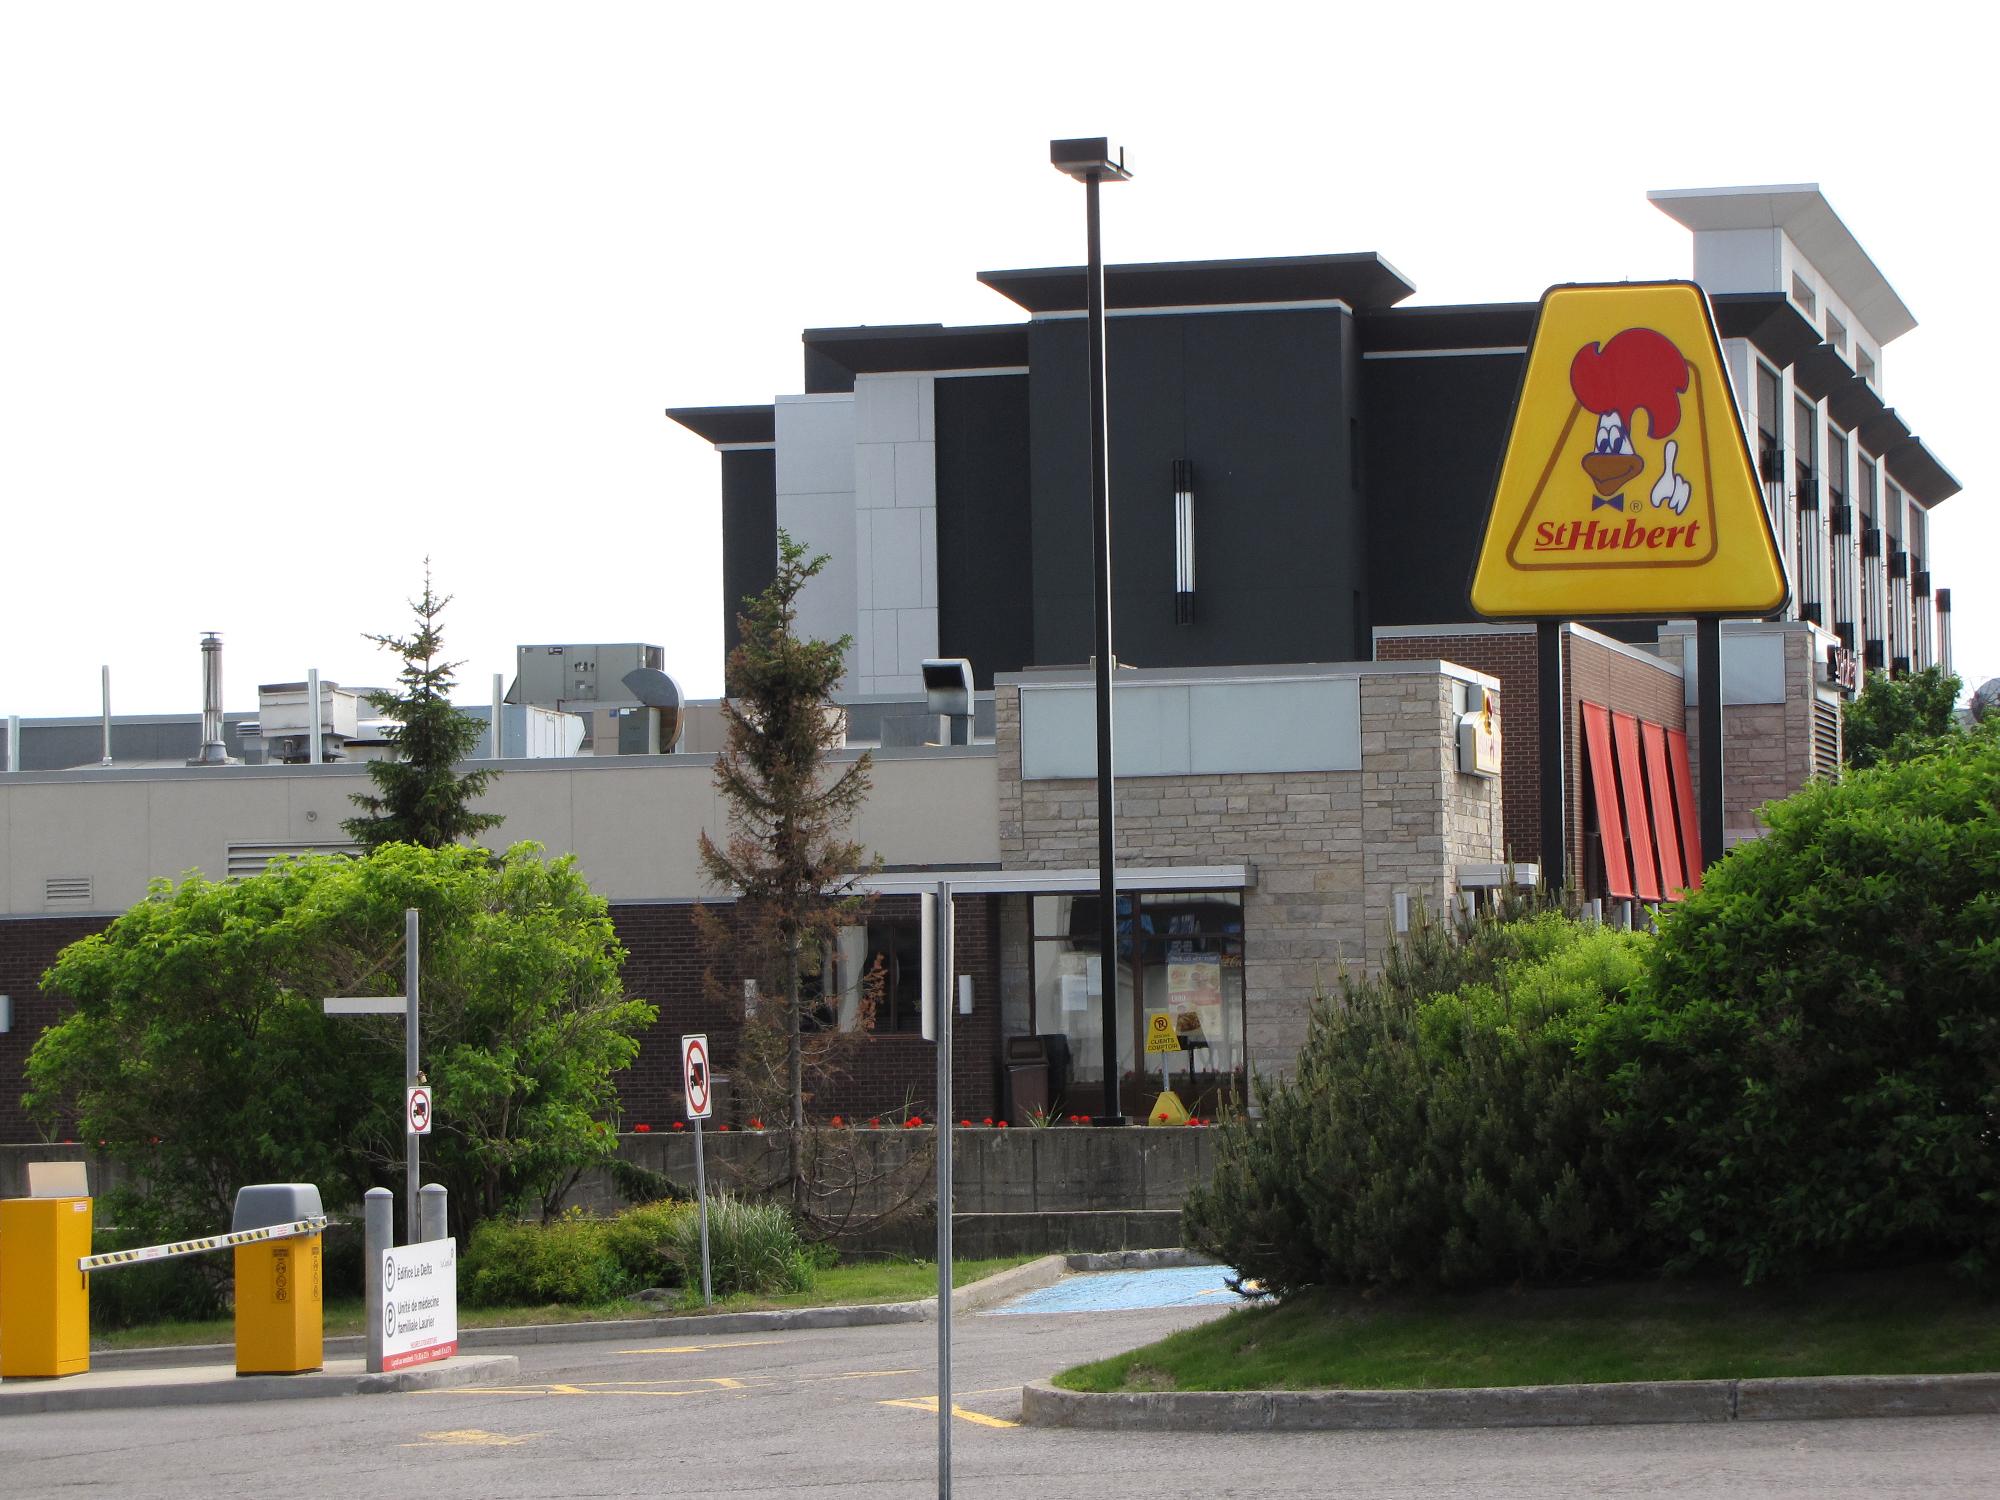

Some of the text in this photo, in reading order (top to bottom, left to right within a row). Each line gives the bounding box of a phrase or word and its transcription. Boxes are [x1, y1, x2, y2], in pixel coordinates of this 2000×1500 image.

[414, 1265, 420, 1277] Le
[420, 1262, 433, 1276] Delta
[397, 1296, 440, 1314] Unité de médecine
[418, 1317, 435, 1331] Laurier
